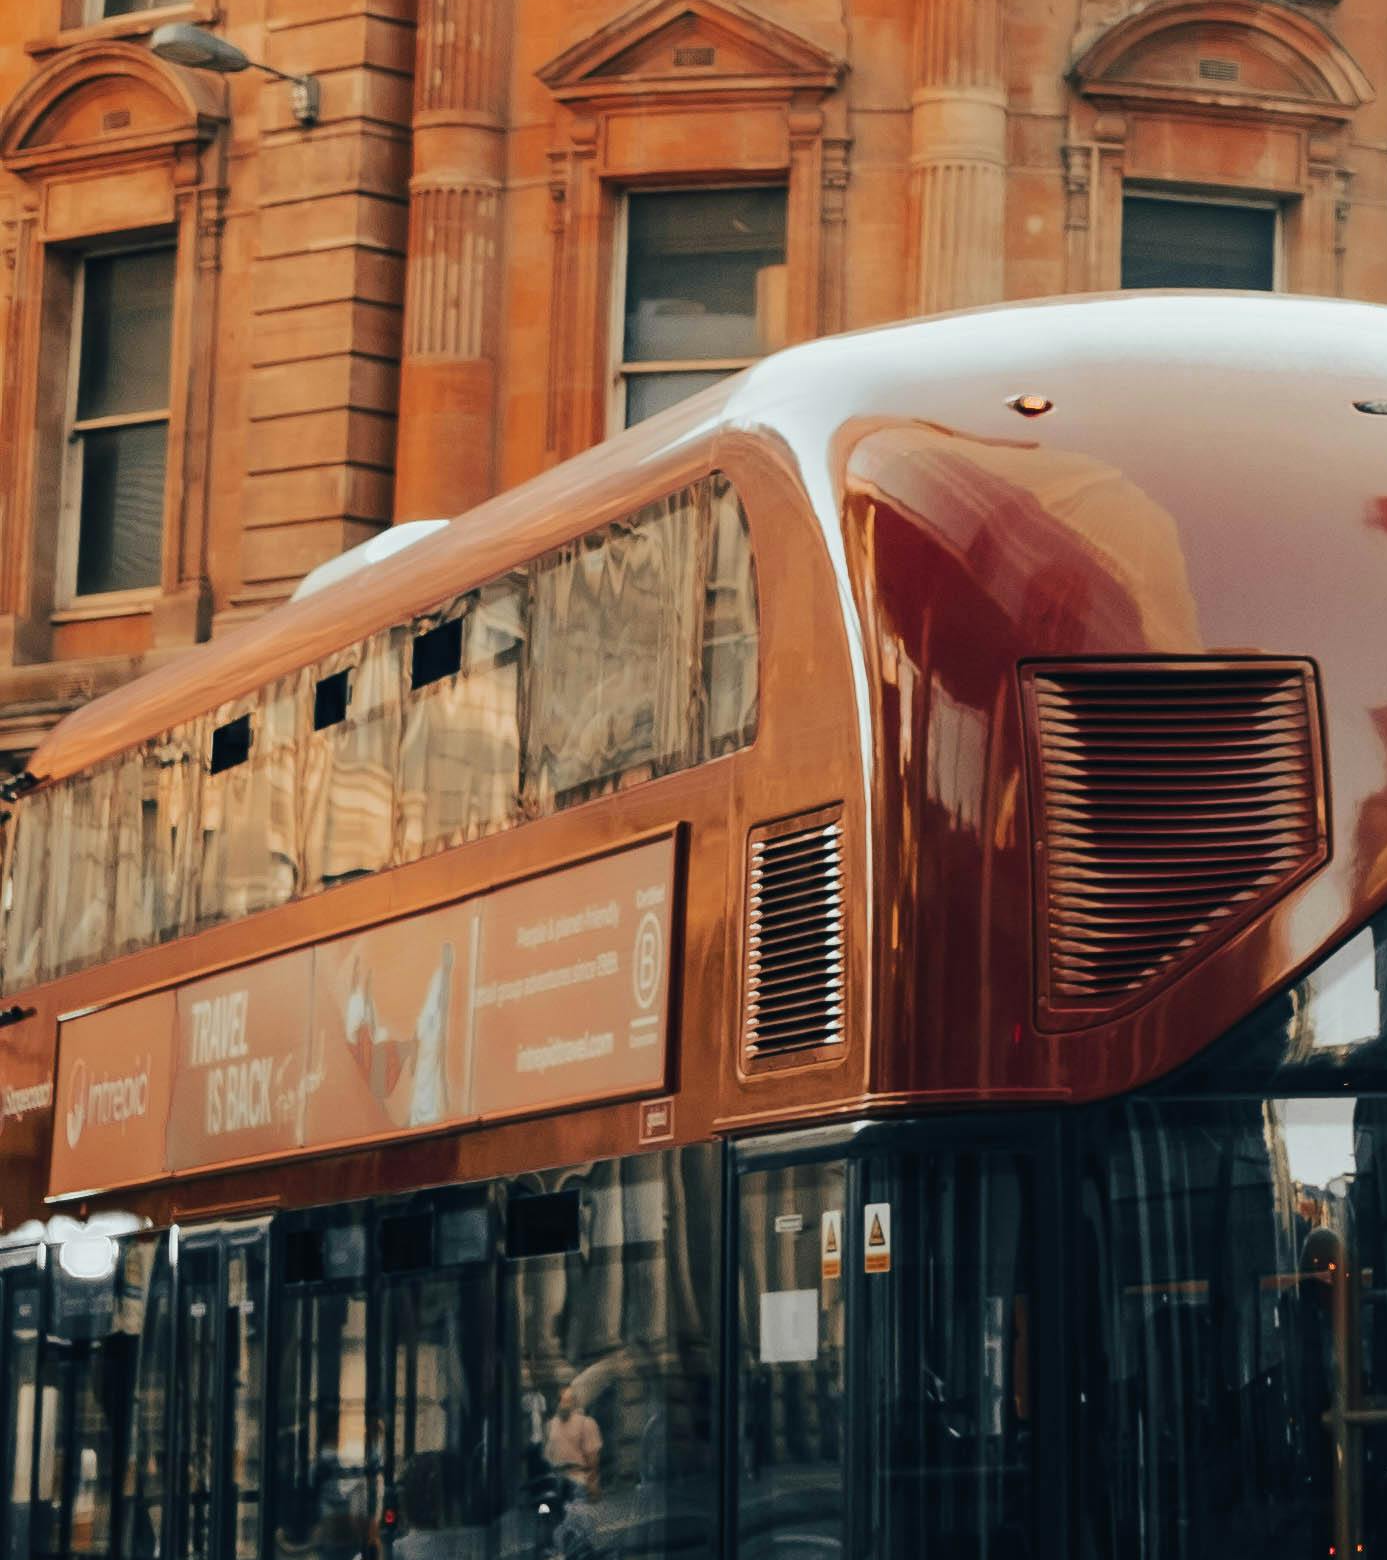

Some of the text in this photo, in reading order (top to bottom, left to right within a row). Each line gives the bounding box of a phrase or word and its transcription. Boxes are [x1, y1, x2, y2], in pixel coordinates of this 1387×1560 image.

[639, 932, 656, 991] B
[192, 991, 249, 1066] TRAVEL
[207, 1067, 222, 1135] IS
[225, 1056, 274, 1132] BACK
